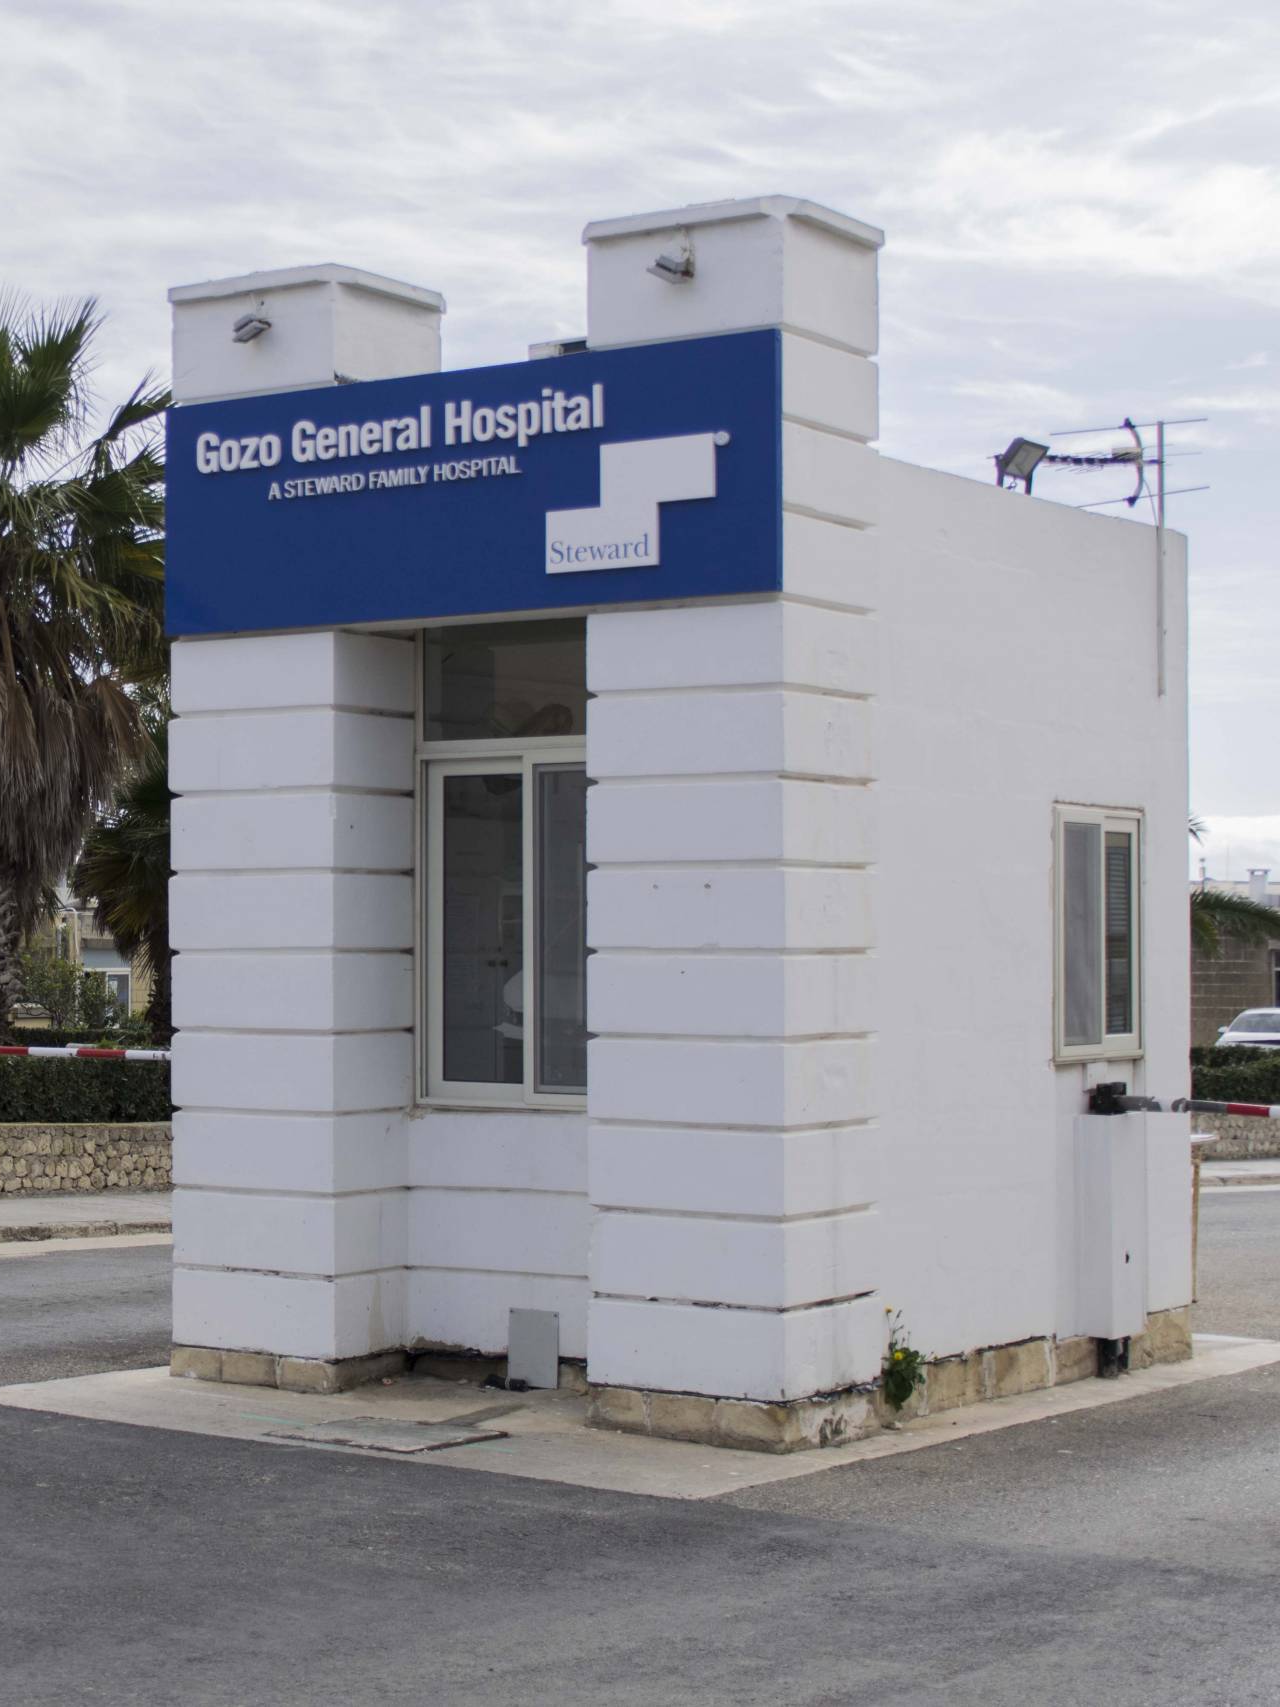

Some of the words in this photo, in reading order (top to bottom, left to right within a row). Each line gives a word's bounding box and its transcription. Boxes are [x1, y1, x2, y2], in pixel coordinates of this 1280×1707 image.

[195, 431, 281, 474] Gozo
[291, 405, 431, 464] General
[444, 383, 604, 447] Hospital
[268, 482, 281, 500] A
[284, 473, 365, 498] STEWARD
[368, 465, 429, 490] FAMILY
[433, 456, 521, 483] HOSPITAL
[549, 532, 650, 565] Steward
